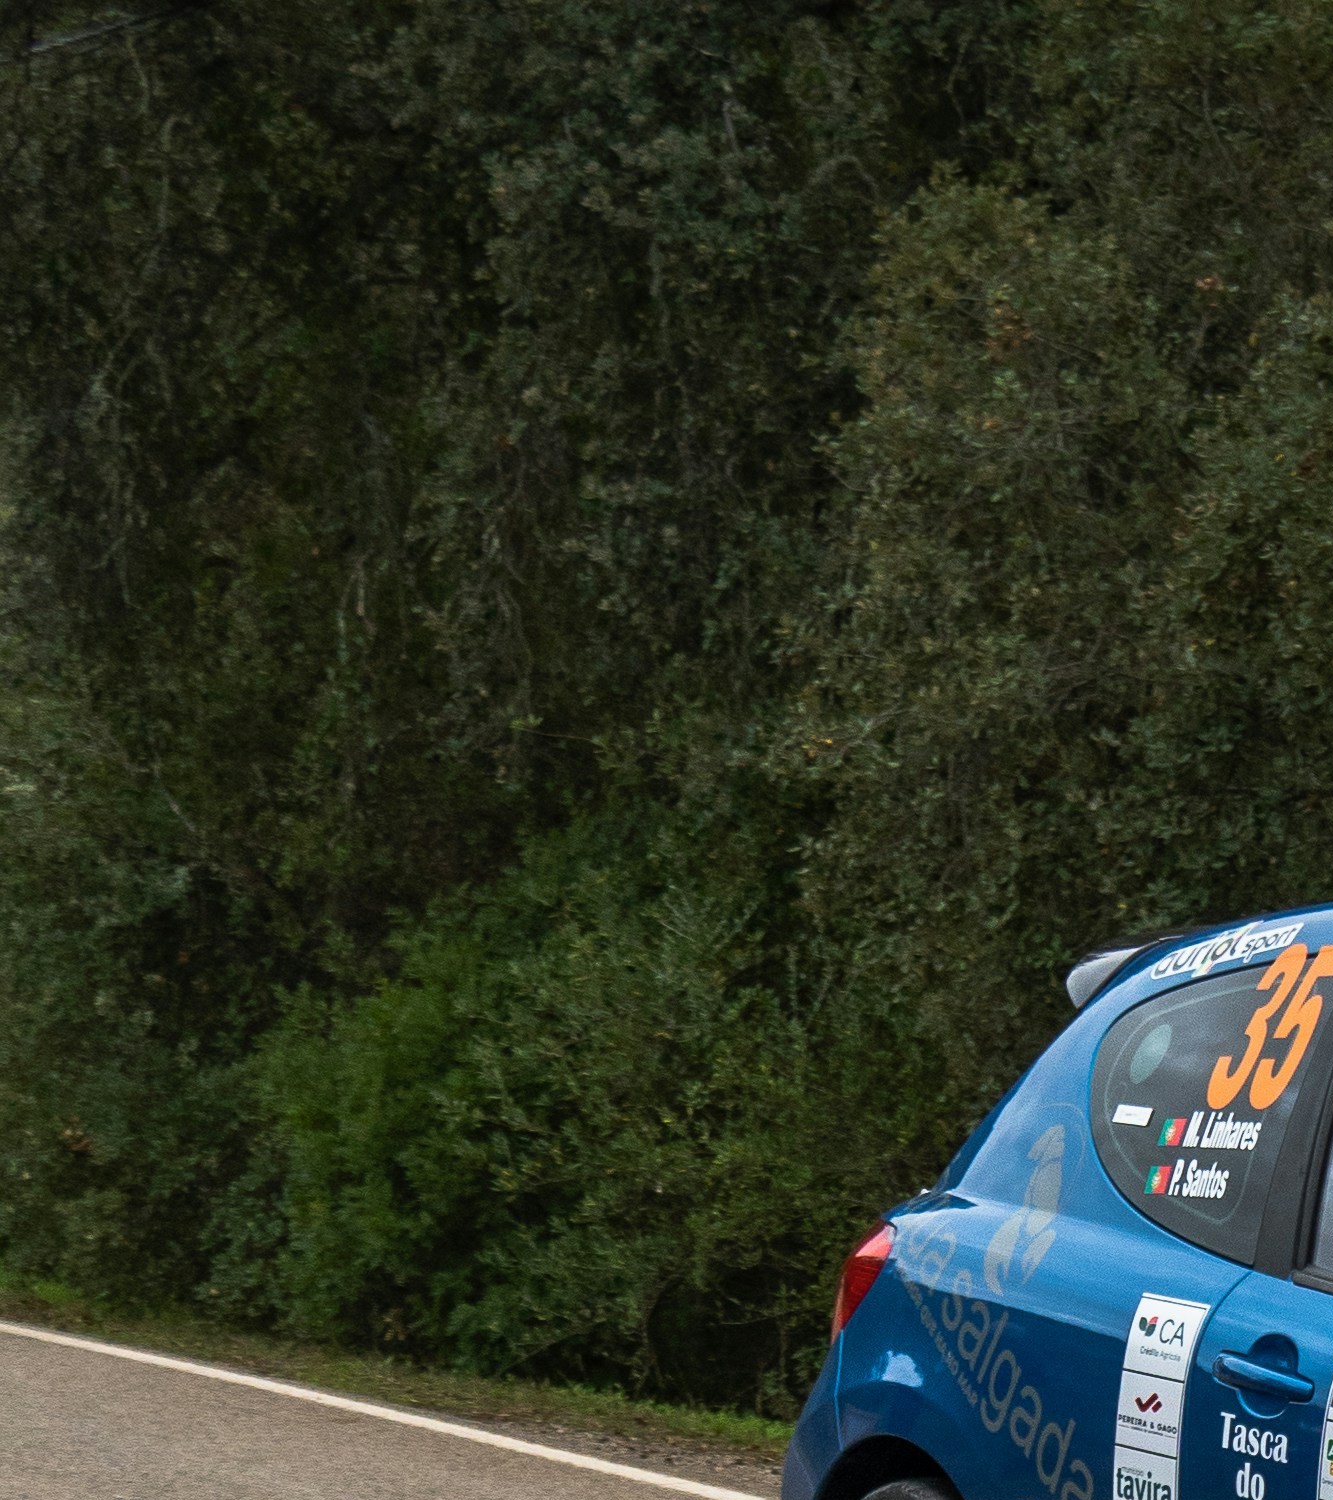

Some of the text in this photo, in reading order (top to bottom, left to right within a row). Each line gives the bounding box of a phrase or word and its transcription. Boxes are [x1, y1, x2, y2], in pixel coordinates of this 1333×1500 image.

[1241, 927, 1297, 959] sport
[1182, 1111, 1262, 1150] M. Linhares
[1167, 1159, 1229, 1199] P. Santos
[1159, 1319, 1184, 1347] CA
[1118, 1414, 1147, 1428] PEREIRA
[1156, 1423, 1177, 1435] GAGO
[1220, 1411, 1288, 1464] Tasca
